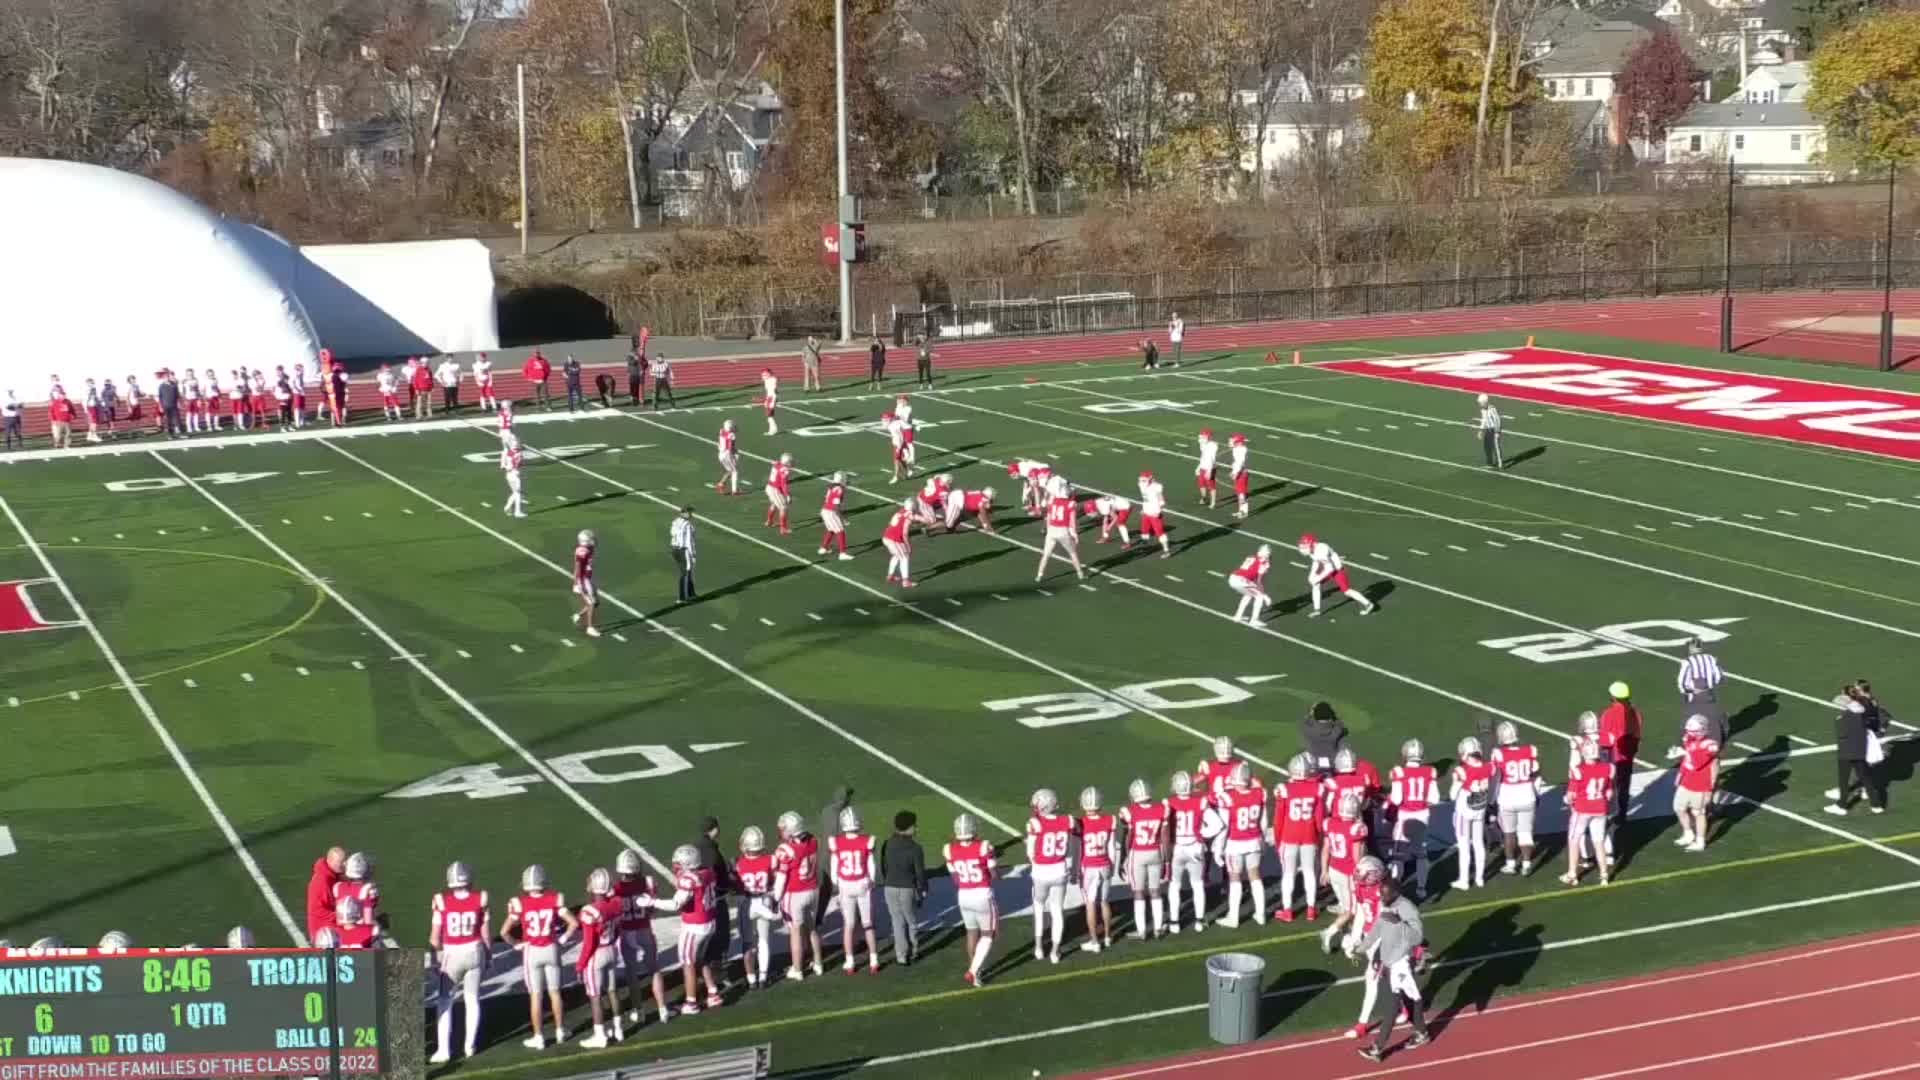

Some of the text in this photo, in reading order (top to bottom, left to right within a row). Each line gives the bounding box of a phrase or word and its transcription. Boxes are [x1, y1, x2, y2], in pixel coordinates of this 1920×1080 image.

[1505, 759, 1531, 783] 90
[1408, 776, 1424, 801] 11
[1289, 797, 1315, 822] 65
[1043, 831, 1068, 856] 83
[1135, 819, 1160, 846] 57
[840, 851, 862, 876] 31
[954, 858, 983, 883] 95
[525, 908, 553, 937] 37
[0, 965, 103, 995] KNIGHTS
[143, 957, 211, 992] 8:46
[35, 1003, 54, 1034] 6
[171, 1002, 227, 1028] 1 QTR
[304, 992, 323, 1023] 0
[28, 1034, 82, 1056] DOWN
[89, 1034, 110, 1054] 10
[115, 1033, 138, 1054] TO
[142, 1032, 166, 1053] GO
[275, 1028, 316, 1049] BALL
[353, 1027, 377, 1048] 24
[2, 1064, 34, 1080] GIFT
[38, 1063, 83, 1079] FROM
[87, 1061, 119, 1077] THE
[121, 1060, 195, 1076] FAMILIES
[200, 1058, 220, 1074] OF
[222, 1057, 253, 1073] THE
[257, 1056, 311, 1073] CLASS
[339, 1055, 376, 1070] 2022
